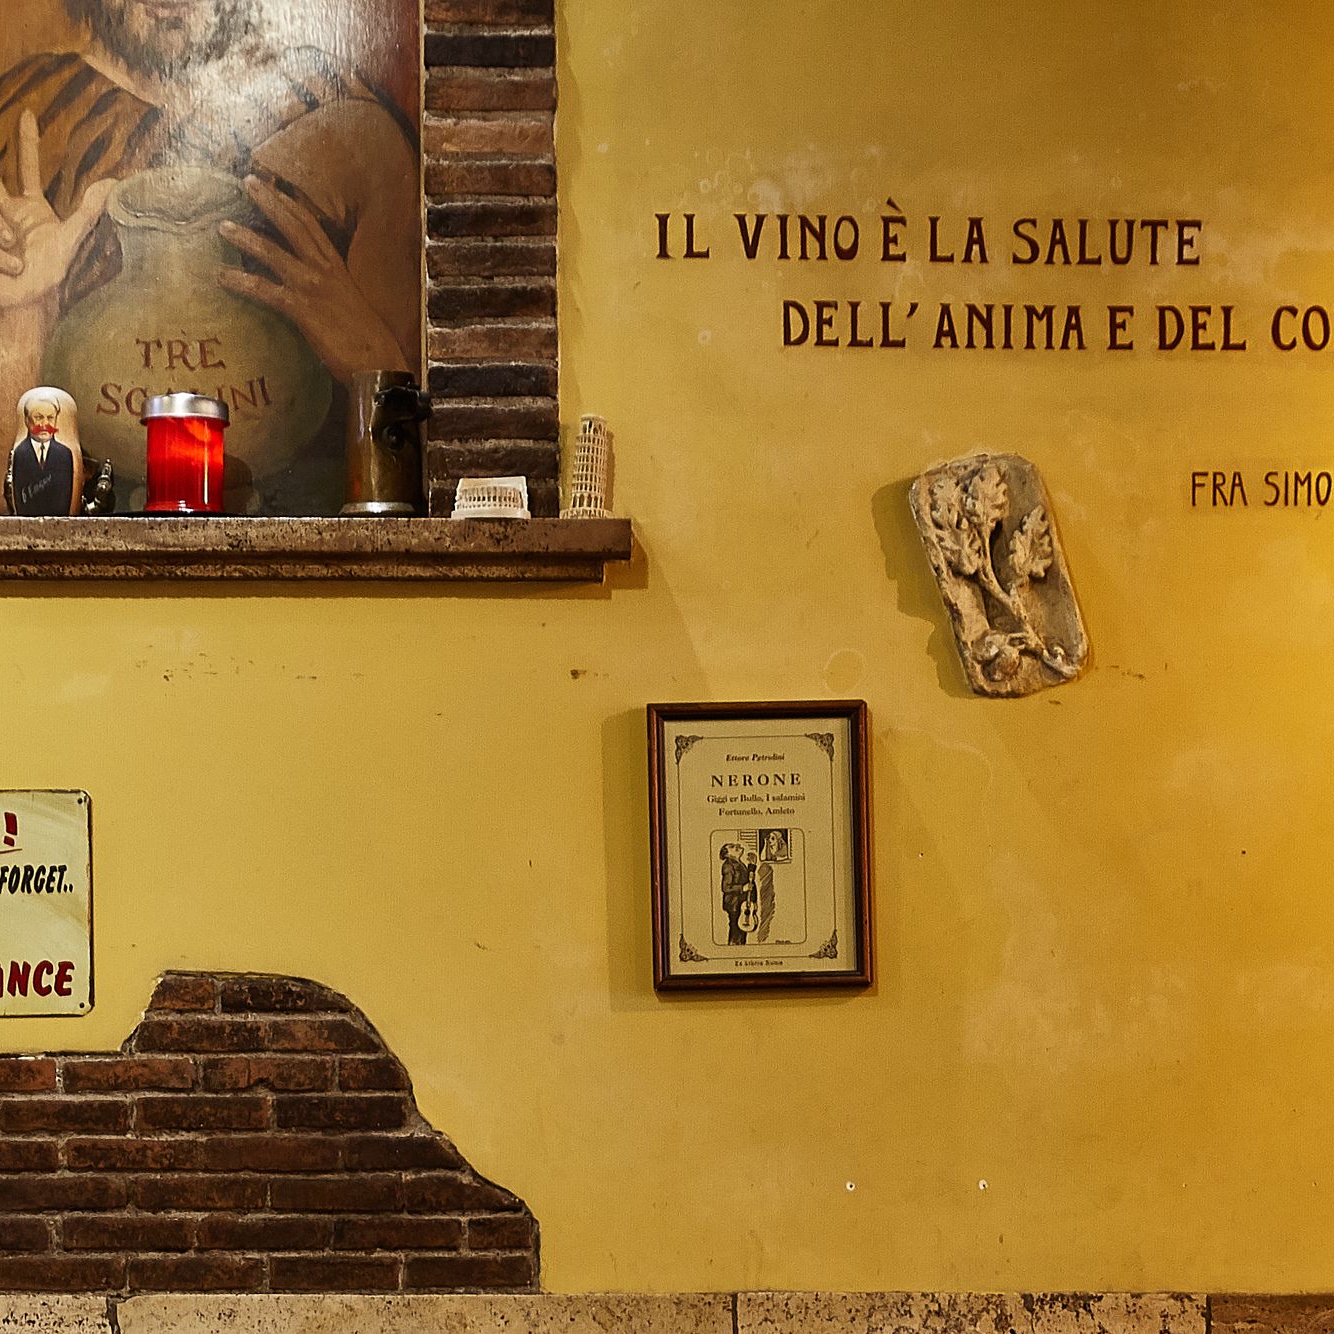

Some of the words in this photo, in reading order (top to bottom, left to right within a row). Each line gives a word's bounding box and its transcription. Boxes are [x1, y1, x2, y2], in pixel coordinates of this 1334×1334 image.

[655, 212, 710, 260] IL
[734, 212, 860, 262] VINO
[880, 198, 908, 263] È
[928, 215, 989, 264] LA
[1012, 217, 1203, 267] SALUTE
[1106, 305, 1135, 351] E
[1157, 306, 1247, 351] DEL
[135, 337, 226, 371] TRE
[1190, 472, 1247, 508] FRA
[710, 772, 801, 788] NERONE
